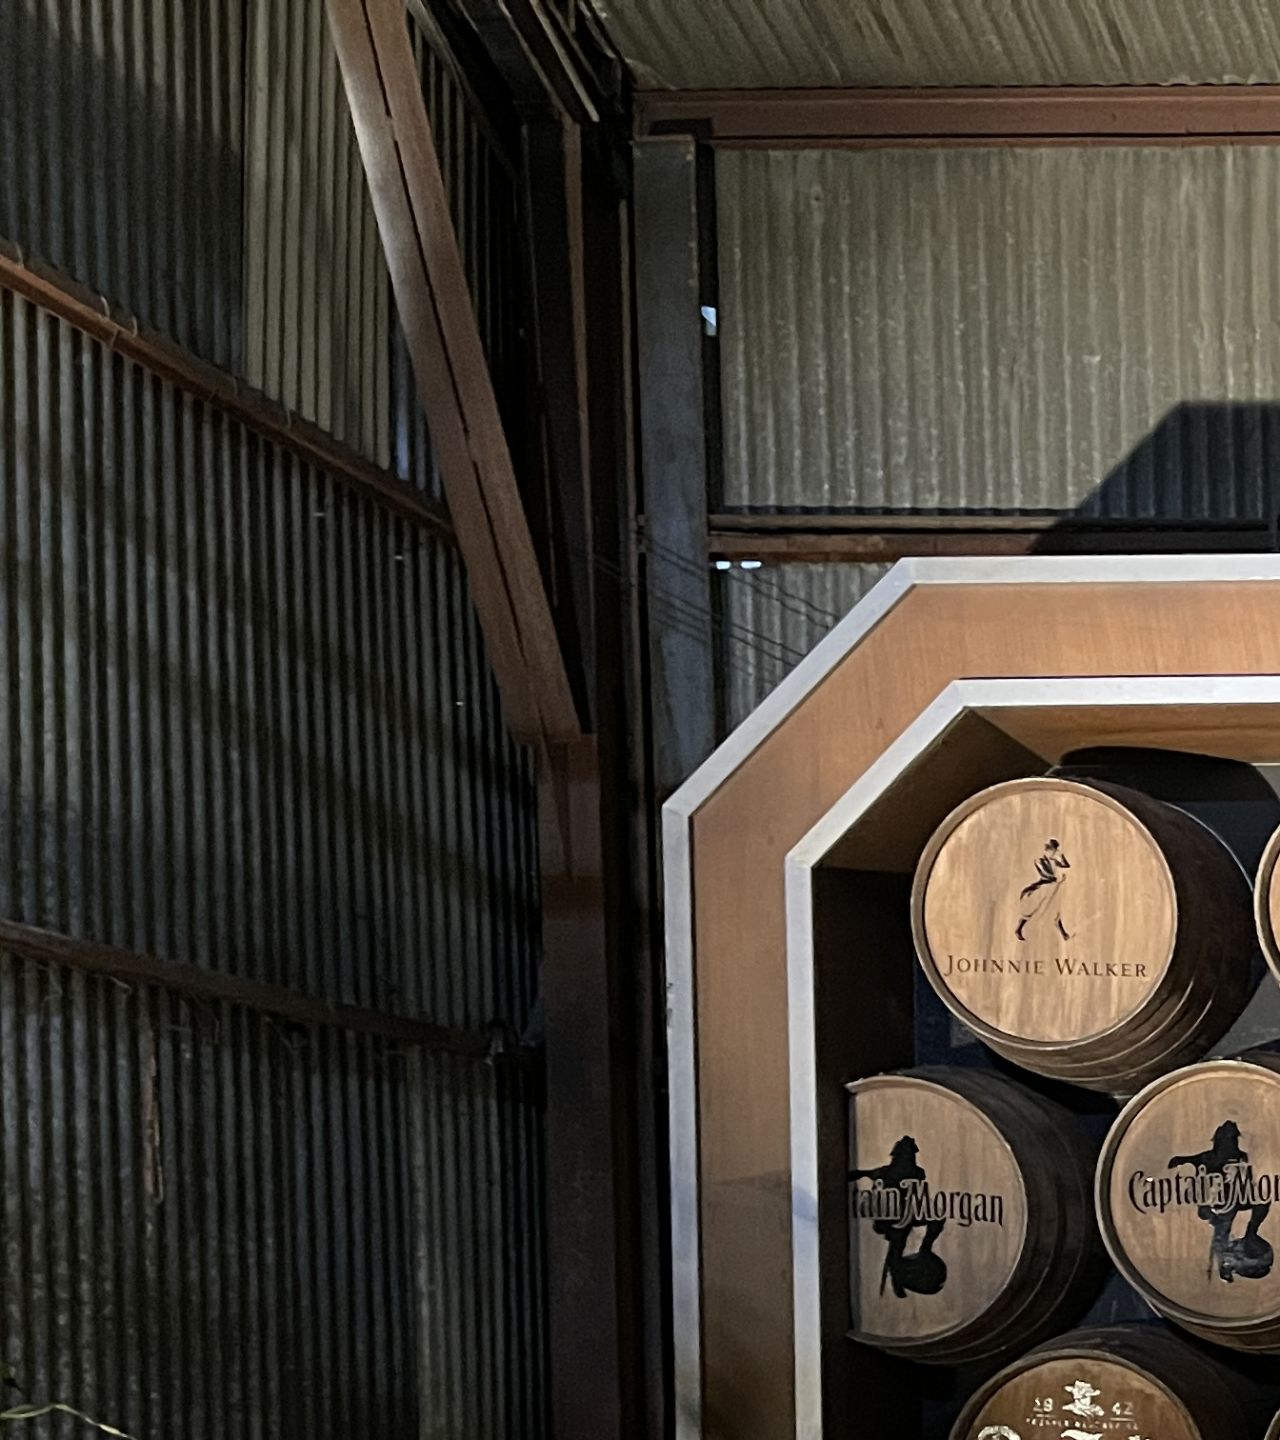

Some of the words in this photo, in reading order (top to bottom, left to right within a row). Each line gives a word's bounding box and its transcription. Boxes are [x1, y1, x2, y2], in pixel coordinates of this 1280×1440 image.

[944, 954, 1045, 977] JOHNNIE
[1055, 957, 1147, 978] WALKER
[892, 1178, 1004, 1229] Morgan
[1128, 1164, 1225, 1215] Captain
